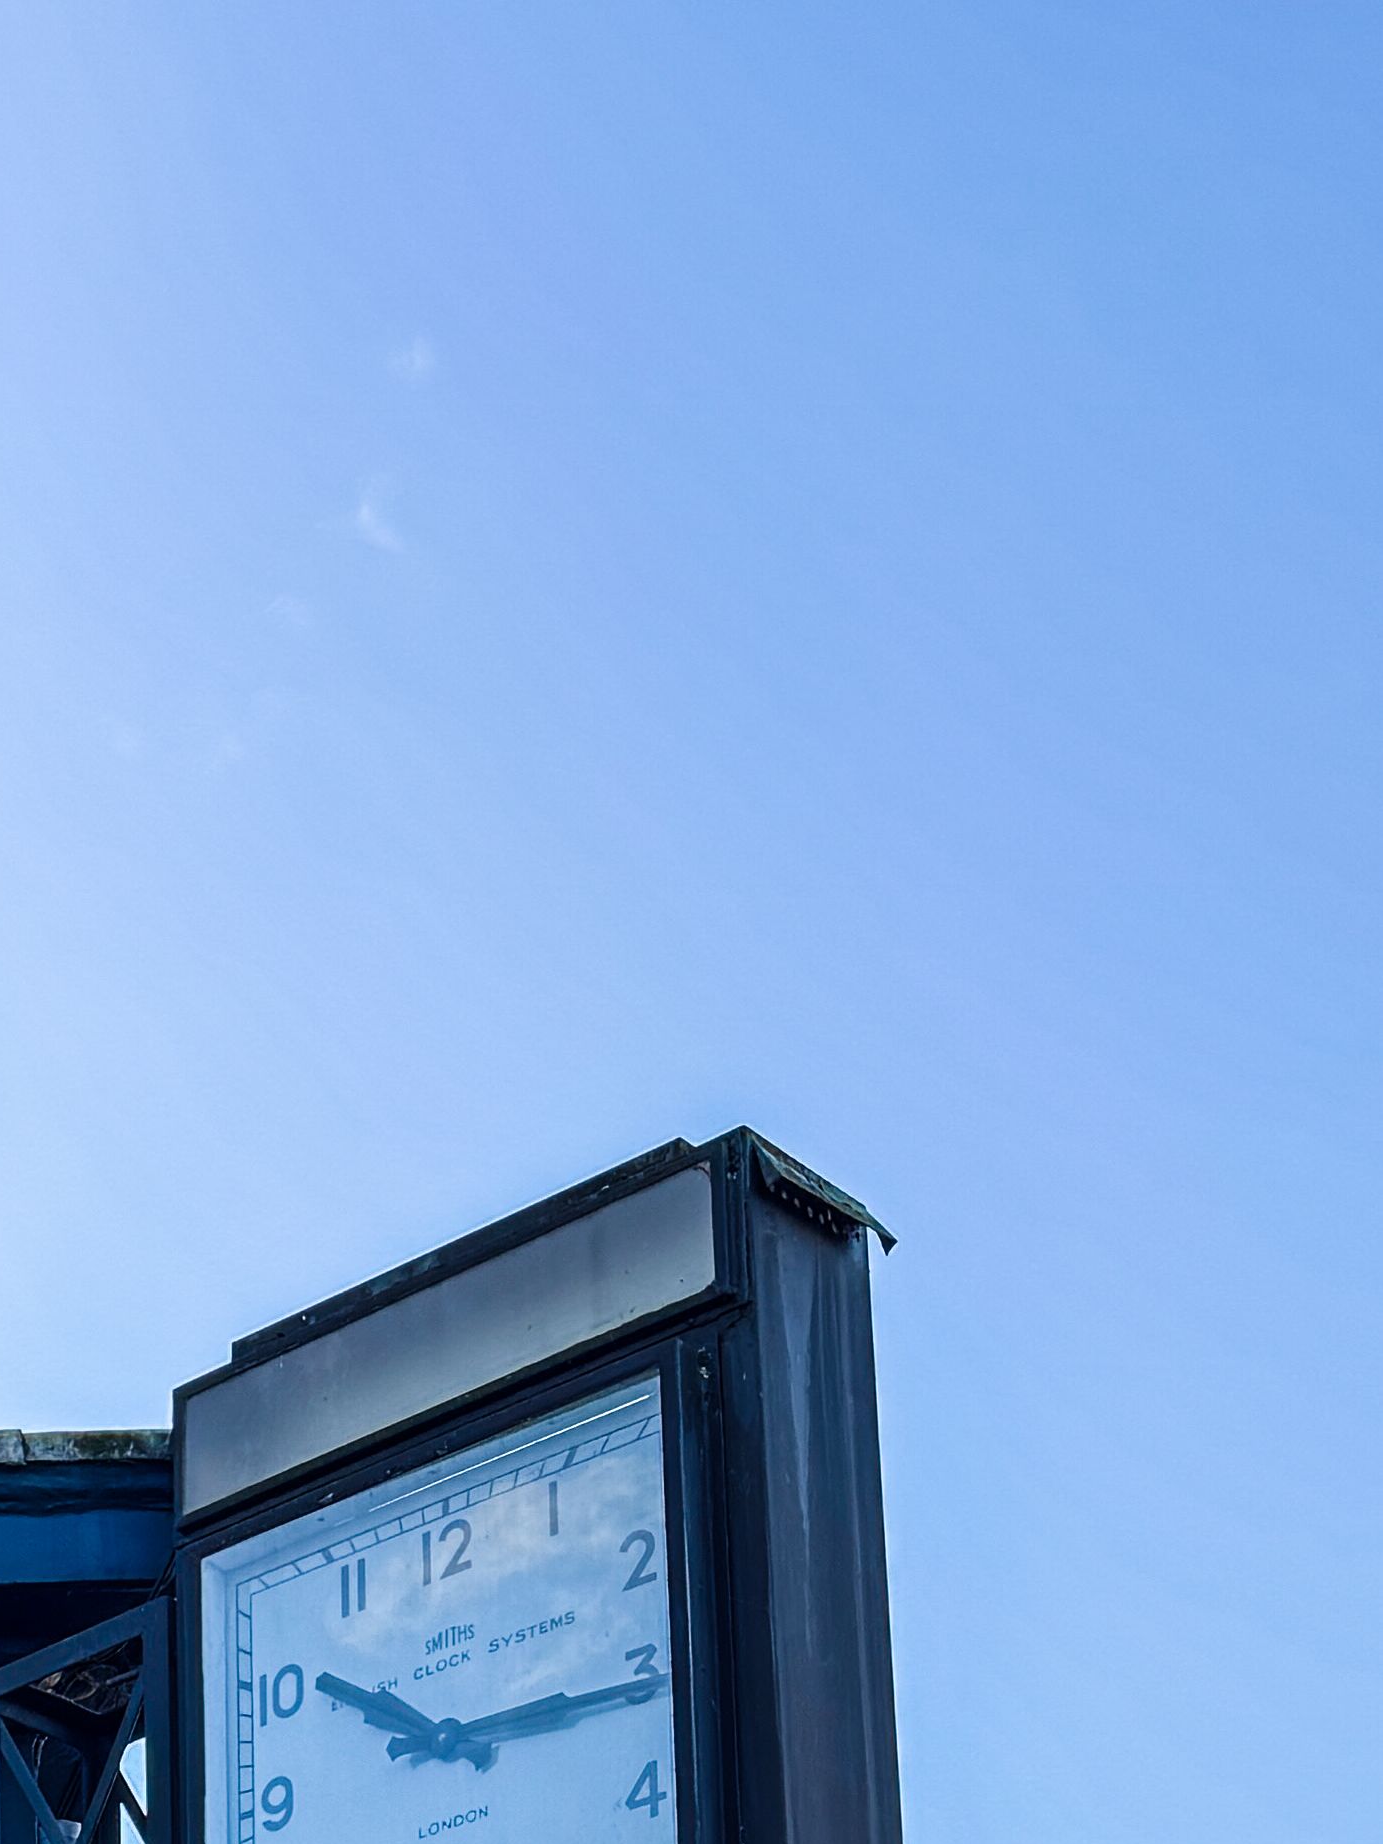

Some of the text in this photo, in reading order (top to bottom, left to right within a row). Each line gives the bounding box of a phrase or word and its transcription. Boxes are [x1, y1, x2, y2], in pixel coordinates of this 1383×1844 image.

[547, 1481, 559, 1538] 1
[420, 1517, 473, 1587] 12
[619, 1529, 658, 1593] 2
[339, 1556, 368, 1620] 11
[413, 1648, 472, 1681] CLOCK
[487, 1610, 577, 1654] SYSTEMS
[424, 1623, 476, 1656] SMITHS
[259, 1663, 304, 1728] 10
[624, 1642, 660, 1706] 3
[261, 1775, 295, 1833] 9
[624, 1759, 668, 1820] 4
[417, 1806, 490, 1840] LONDON
